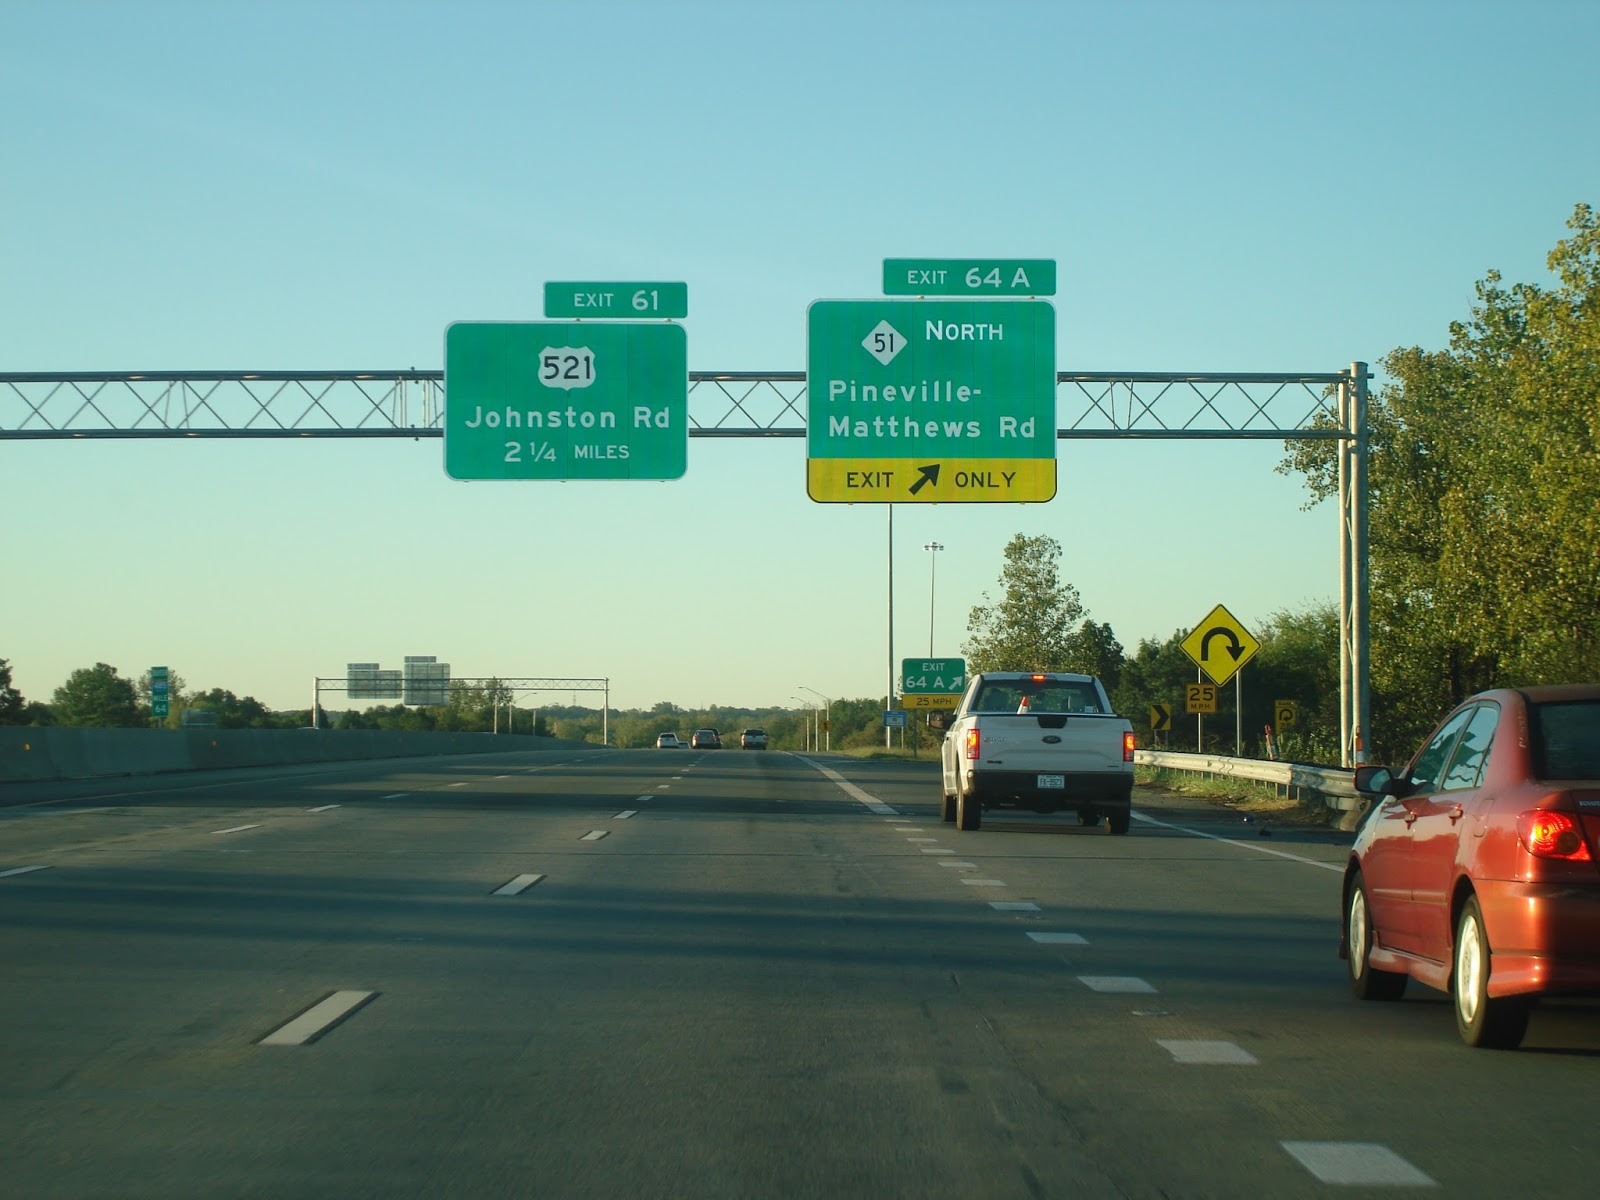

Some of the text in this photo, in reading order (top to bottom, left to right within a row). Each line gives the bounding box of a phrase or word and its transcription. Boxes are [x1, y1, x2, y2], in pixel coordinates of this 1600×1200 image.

[907, 267, 1030, 288] EXIT 64 A
[574, 290, 658, 310] EXIT 61
[926, 320, 1003, 341] NORTH
[874, 333, 894, 353] 51
[543, 355, 591, 380] 521
[829, 380, 982, 402] Pineville-
[464, 405, 670, 428] Johnston Rd
[829, 415, 1035, 438] Matthews Rd
[504, 441, 521, 462] 2
[575, 445, 630, 459] MILES
[846, 472, 1017, 488] EXIT ONLY
[922, 662, 945, 671] EXIT
[906, 676, 945, 688] 64 A
[916, 697, 930, 706] 25
[1189, 687, 1213, 701] 25
[155, 704, 167, 713] 64
